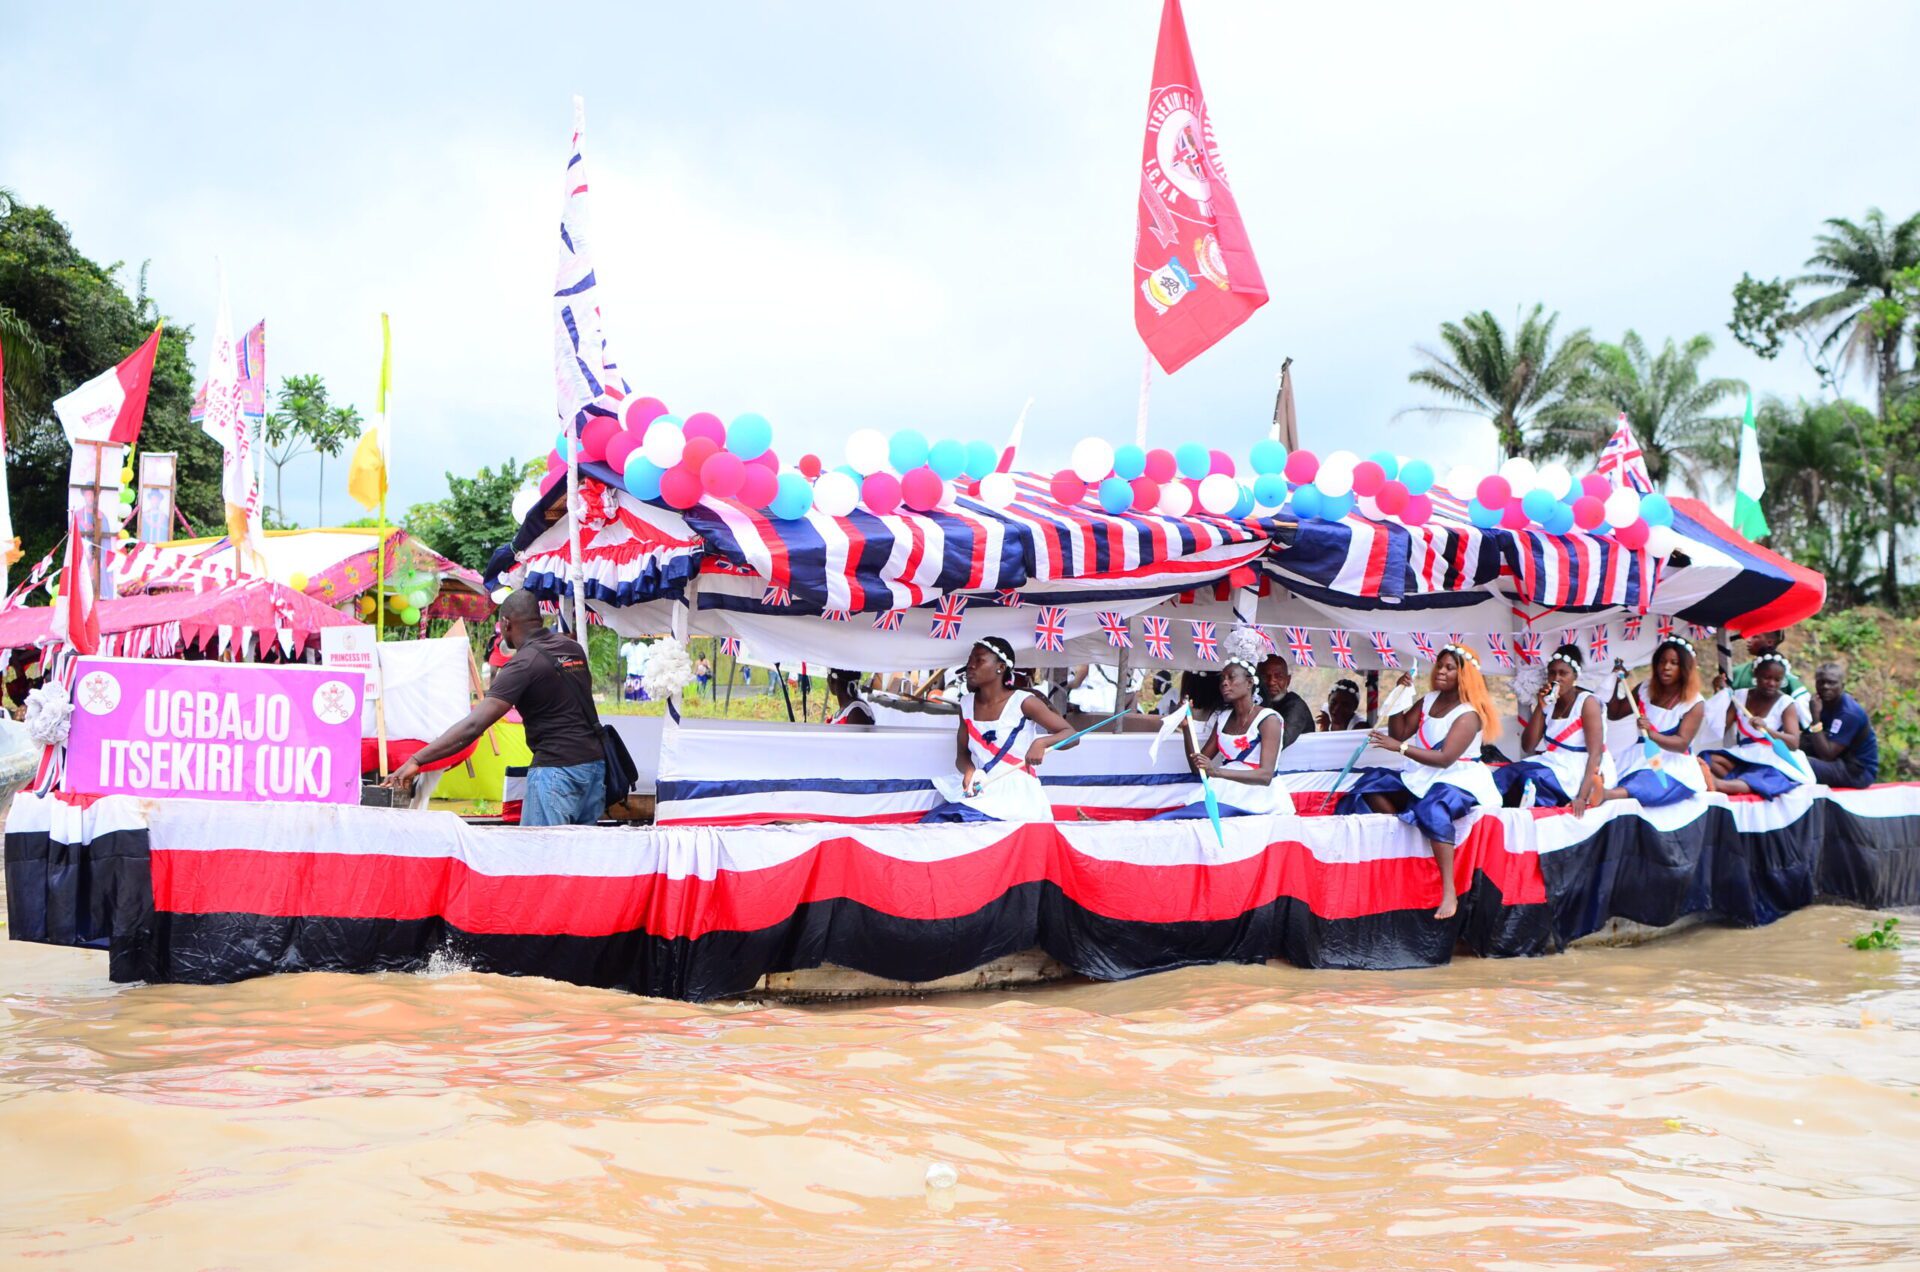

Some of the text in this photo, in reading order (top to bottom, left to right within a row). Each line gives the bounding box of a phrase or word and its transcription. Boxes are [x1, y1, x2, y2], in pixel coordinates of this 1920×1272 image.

[330, 653, 360, 662] PRINCESS
[145, 689, 291, 742] UGBAJO
[99, 739, 332, 798] ITSEKIRI (UK)
